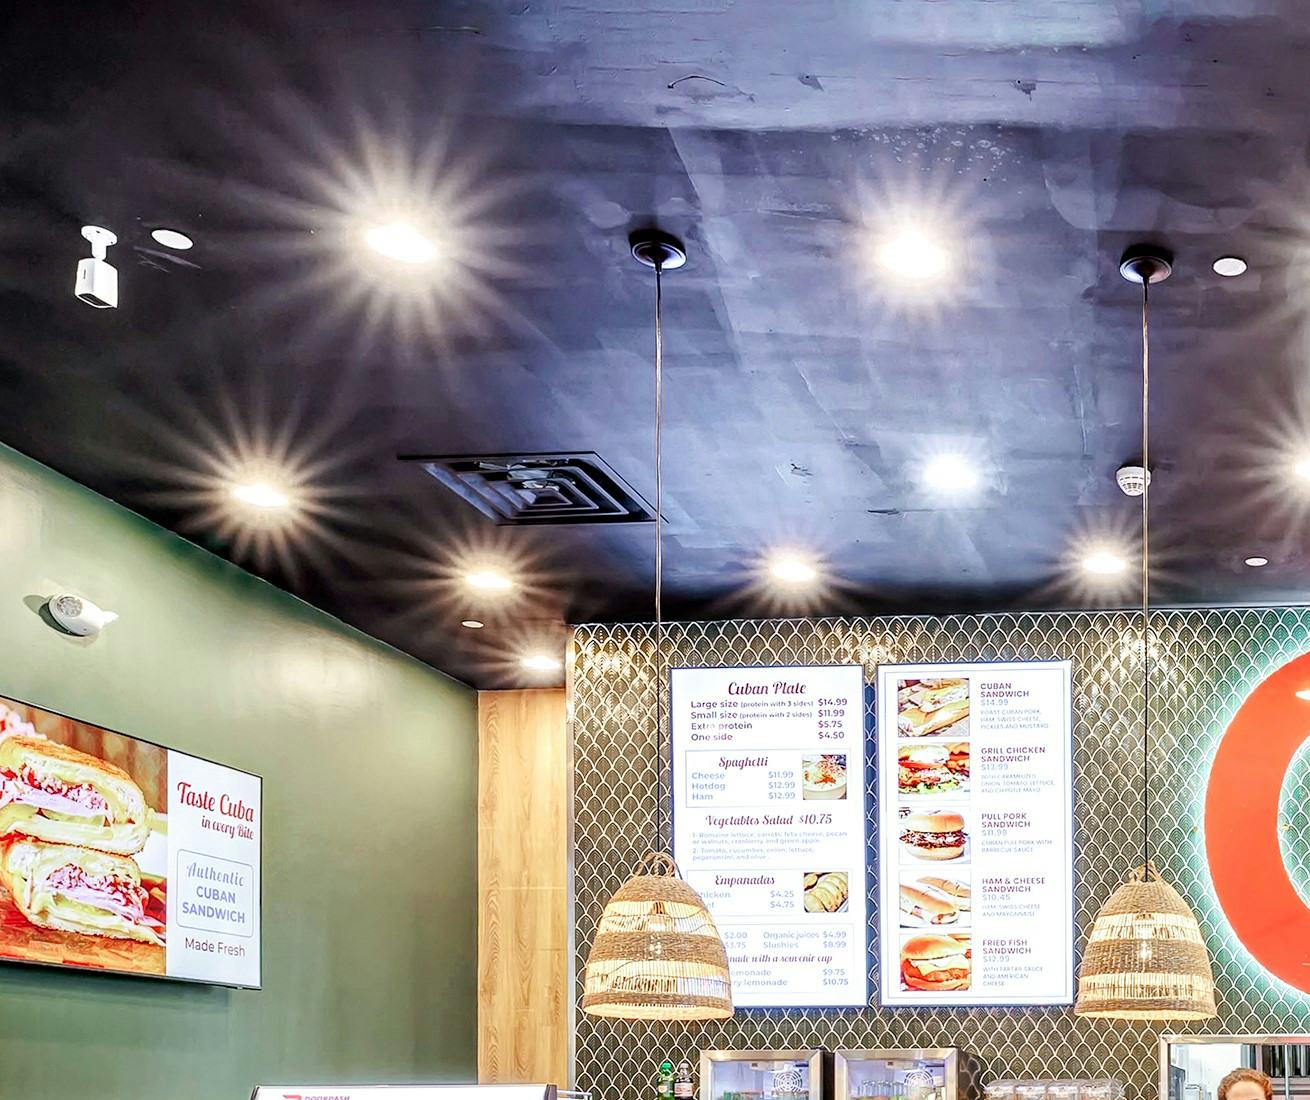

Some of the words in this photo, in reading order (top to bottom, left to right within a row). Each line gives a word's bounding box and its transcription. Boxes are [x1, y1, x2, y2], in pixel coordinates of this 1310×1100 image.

[728, 681, 769, 695] Cuban
[772, 680, 807, 695] Plate
[980, 682, 1012, 690] CUBAN
[980, 690, 1030, 698] SANDWICH
[690, 700, 718, 709] Large
[719, 699, 738, 708] size
[817, 697, 848, 707] $14.99
[690, 711, 717, 719] Small
[719, 710, 738, 719] size
[817, 709, 845, 718] $11.99
[718, 721, 753, 731] protein
[817, 720, 843, 729] $5.75
[690, 733, 711, 741] One
[713, 733, 733, 741] side
[817, 731, 845, 740] $4.50
[1006, 746, 1046, 754] CHICKEN
[718, 756, 769, 770] Spaghetti
[980, 755, 1030, 763] SANDWICH
[691, 772, 726, 780] Cheese
[767, 770, 794, 779] $11.99
[691, 782, 726, 791] Hotdog
[767, 781, 796, 789] $12.99
[691, 793, 714, 801] Ham
[767, 791, 796, 800] $12.99
[176, 780, 216, 813] Taste
[219, 793, 255, 823] Cuba
[705, 814, 760, 829] Vegetables
[762, 814, 794, 826] Salad
[799, 813, 833, 825] $10.75
[1003, 812, 1027, 820] PORK
[201, 815, 211, 829] in
[212, 820, 236, 839] every
[237, 823, 254, 840] Bite
[981, 820, 1031, 828] SANDWICH
[186, 861, 244, 887] Authentic
[714, 874, 775, 888] Empanadas
[982, 877, 1003, 885] HAM
[1004, 877, 1011, 885] &
[1013, 877, 1046, 885] CHEESE
[981, 885, 1032, 893] SANDWICH
[195, 885, 236, 905] CUBAN
[696, 890, 731, 899] hicken
[769, 890, 795, 898] $4.25
[769, 900, 795, 909] $4.75
[182, 901, 246, 924] SANDWICH
[763, 931, 796, 941] Organic
[796, 931, 819, 940] juices
[822, 930, 847, 939] $4.99
[184, 936, 215, 953] Made
[217, 940, 246, 958] Fresh
[763, 941, 800, 949] Slushies
[982, 939, 1007, 947] FRIED
[1008, 939, 1028, 947] FISH
[982, 947, 1032, 955] SANDWICH
[731, 969, 772, 977] emonade
[822, 968, 846, 976] $9.75
[822, 977, 849, 986] $10.75
